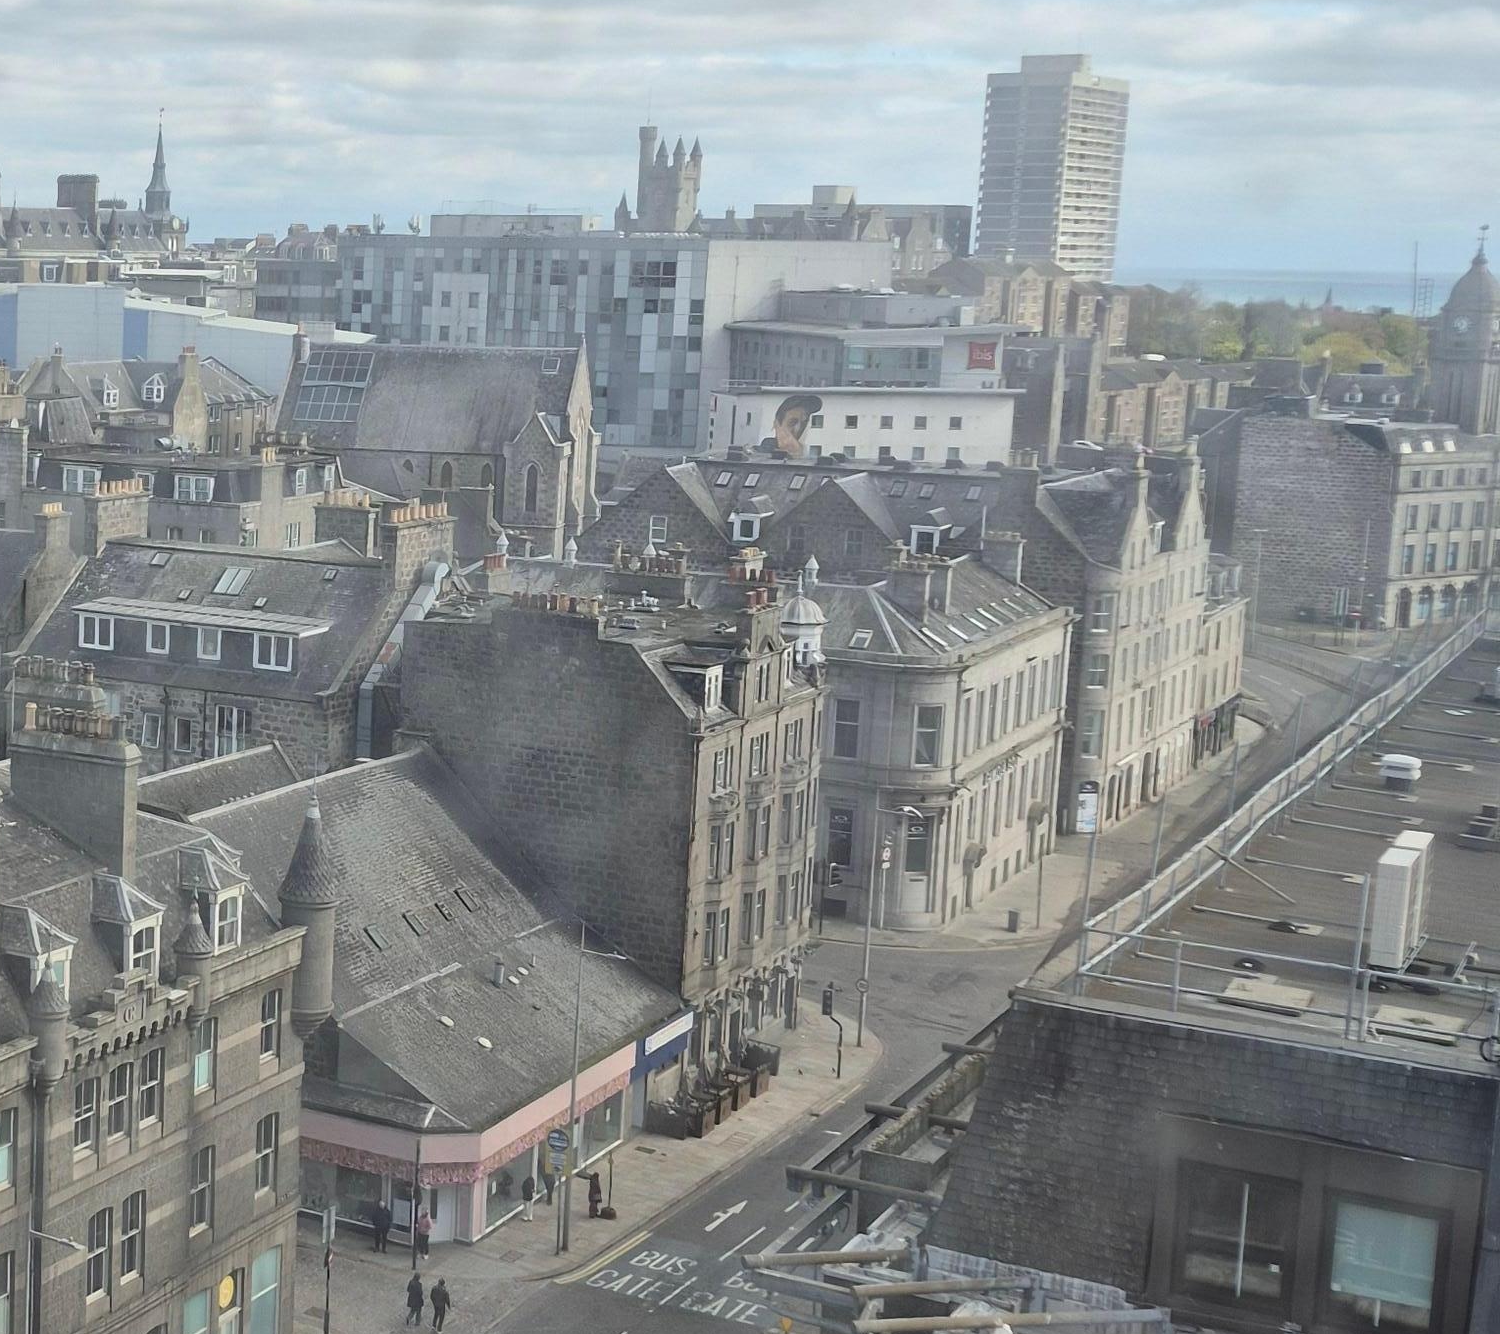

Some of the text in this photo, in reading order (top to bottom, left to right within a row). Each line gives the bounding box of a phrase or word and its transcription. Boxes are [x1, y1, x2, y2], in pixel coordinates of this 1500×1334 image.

[629, 1250, 698, 1275] BUS
[585, 1269, 675, 1300] GATE
[680, 1291, 768, 1325] GATE
